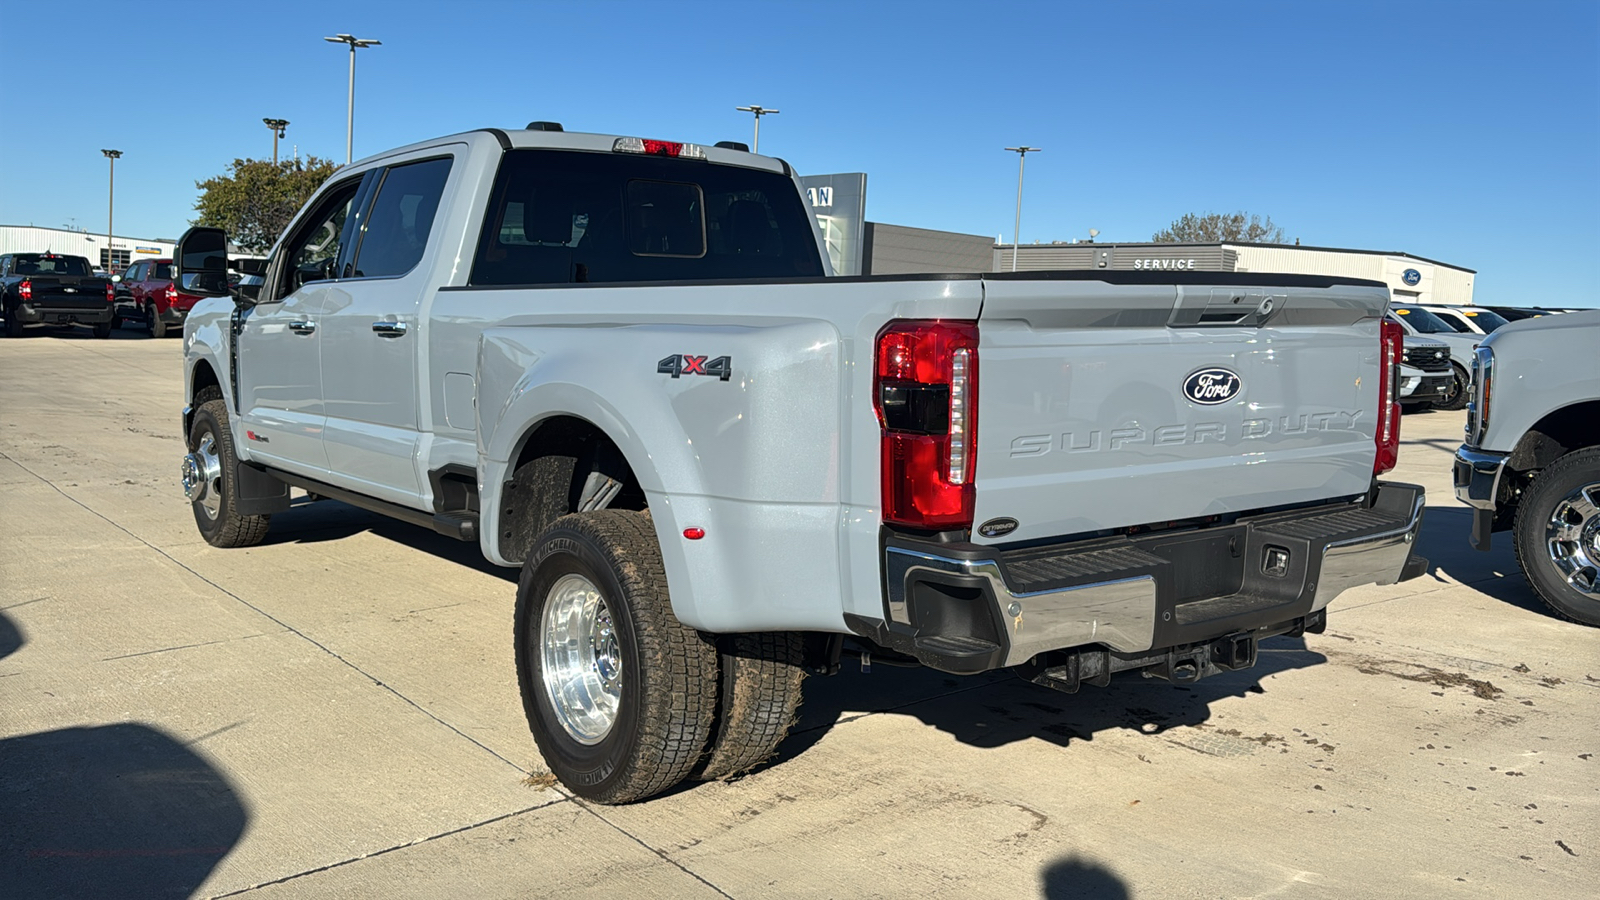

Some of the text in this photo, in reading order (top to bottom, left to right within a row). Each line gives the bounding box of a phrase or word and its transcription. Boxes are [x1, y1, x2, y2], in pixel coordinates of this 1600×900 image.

[1134, 259, 1195, 269] SERVICE
[1194, 374, 1232, 398] Ford
[1010, 409, 1364, 458] SUPER DUTY
[539, 538, 580, 560] MICHELIN
